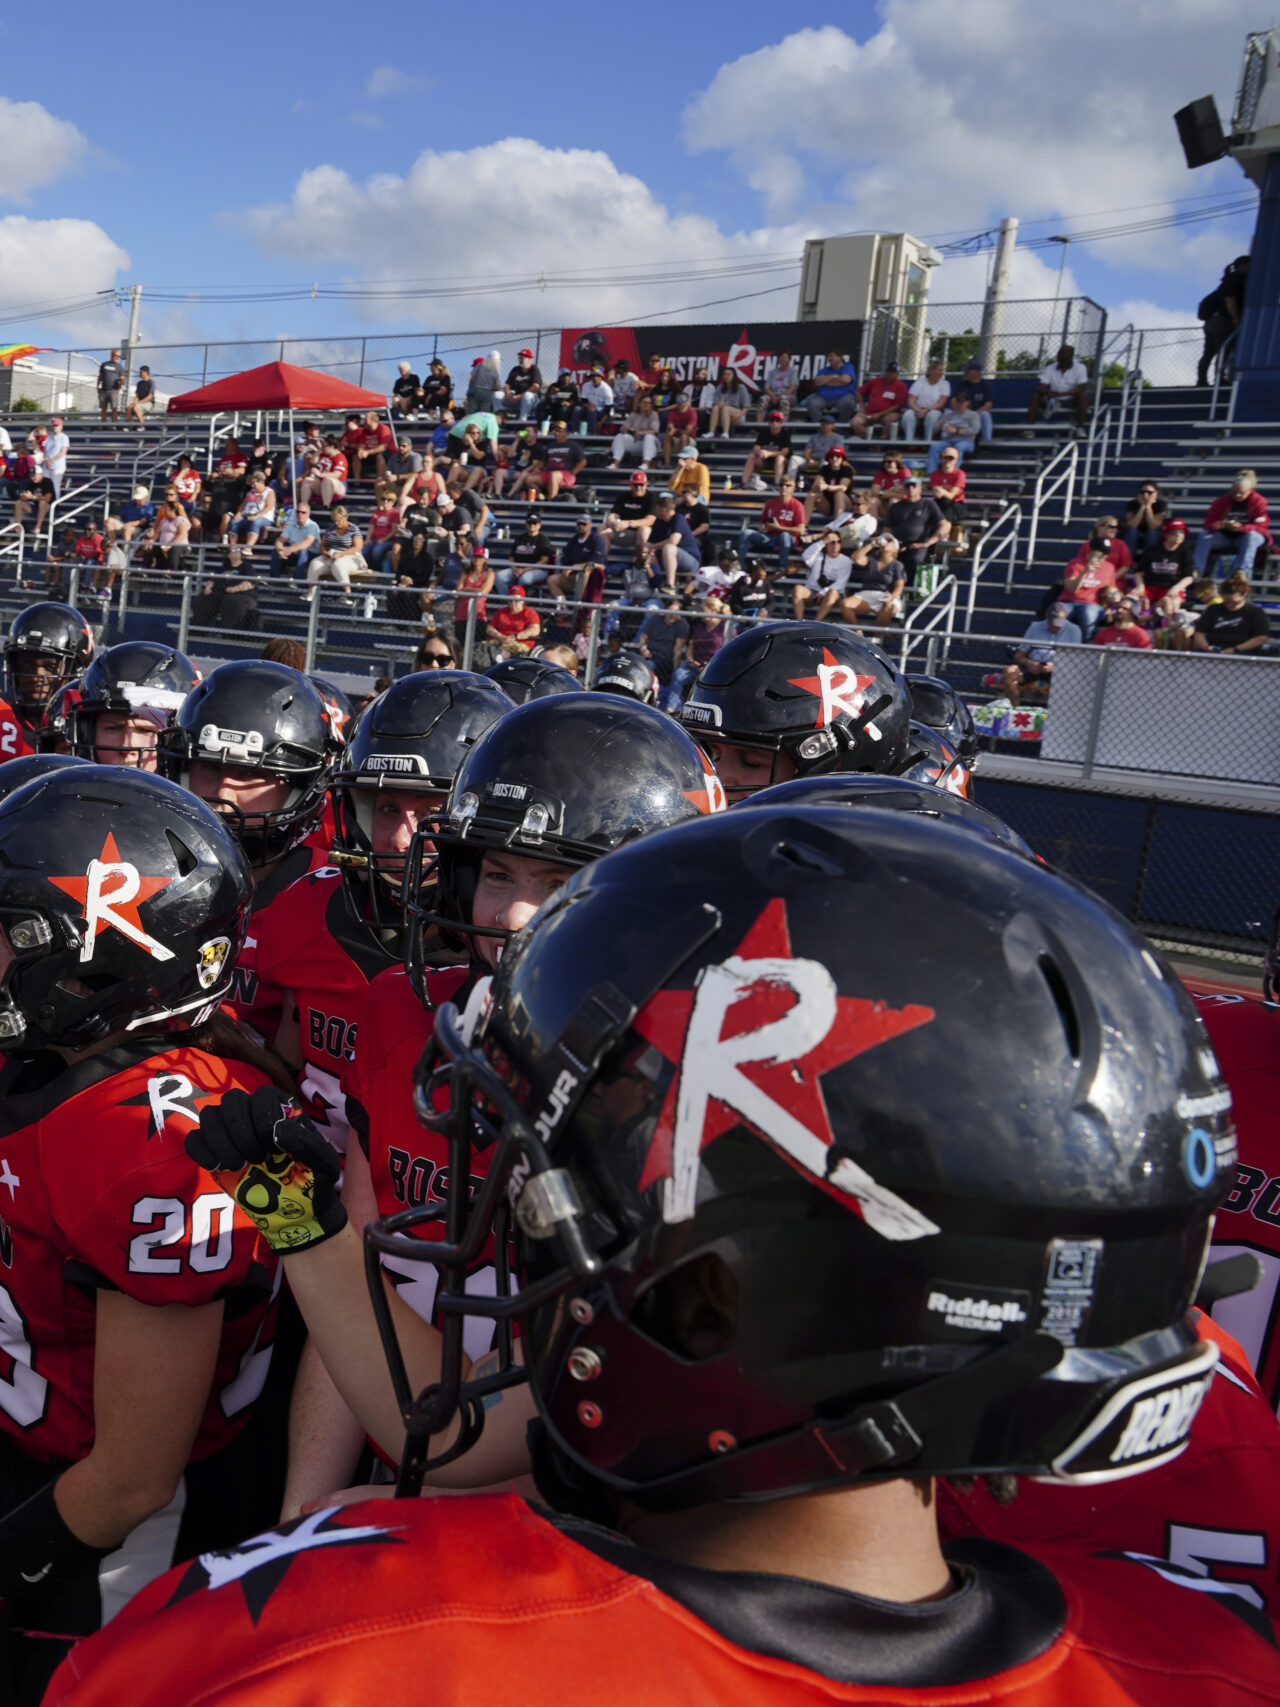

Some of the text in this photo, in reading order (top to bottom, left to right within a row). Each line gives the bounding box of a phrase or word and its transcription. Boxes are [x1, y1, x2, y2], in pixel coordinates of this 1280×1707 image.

[779, 509, 794, 521] 32
[817, 664, 882, 741] R
[367, 756, 413, 772] BOSTON
[493, 783, 527, 800] BOSTON
[80, 858, 175, 962] R
[147, 1073, 201, 1143] R
[662, 954, 942, 1242] R
[127, 1190, 236, 1275] 20
[927, 1291, 1021, 1322] Riddell
[945, 1314, 1004, 1333] MEDIUM
